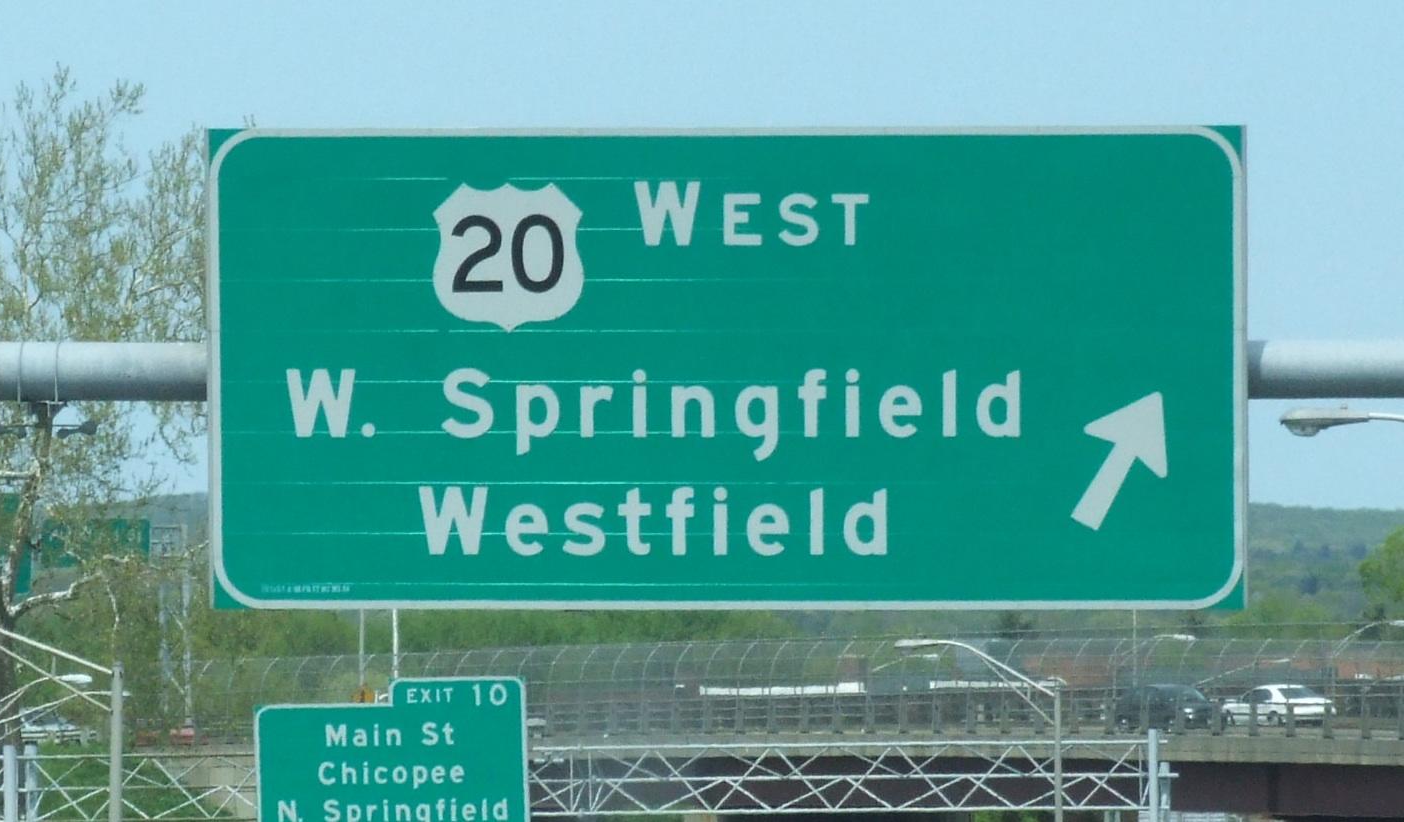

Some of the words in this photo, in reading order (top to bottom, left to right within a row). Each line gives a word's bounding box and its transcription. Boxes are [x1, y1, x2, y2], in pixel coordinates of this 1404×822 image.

[634, 181, 869, 246] WEST
[451, 214, 565, 293] 20
[286, 368, 376, 438] W.
[442, 368, 1022, 460] Springfield
[418, 487, 888, 556] Westfield
[406, 687, 453, 704] EXIT
[472, 683, 507, 706] 10
[325, 724, 402, 747] Main
[421, 722, 455, 746] St
[318, 762, 465, 789] Chicopee
[277, 800, 303, 822] N.
[323, 798, 508, 822] Springfield
